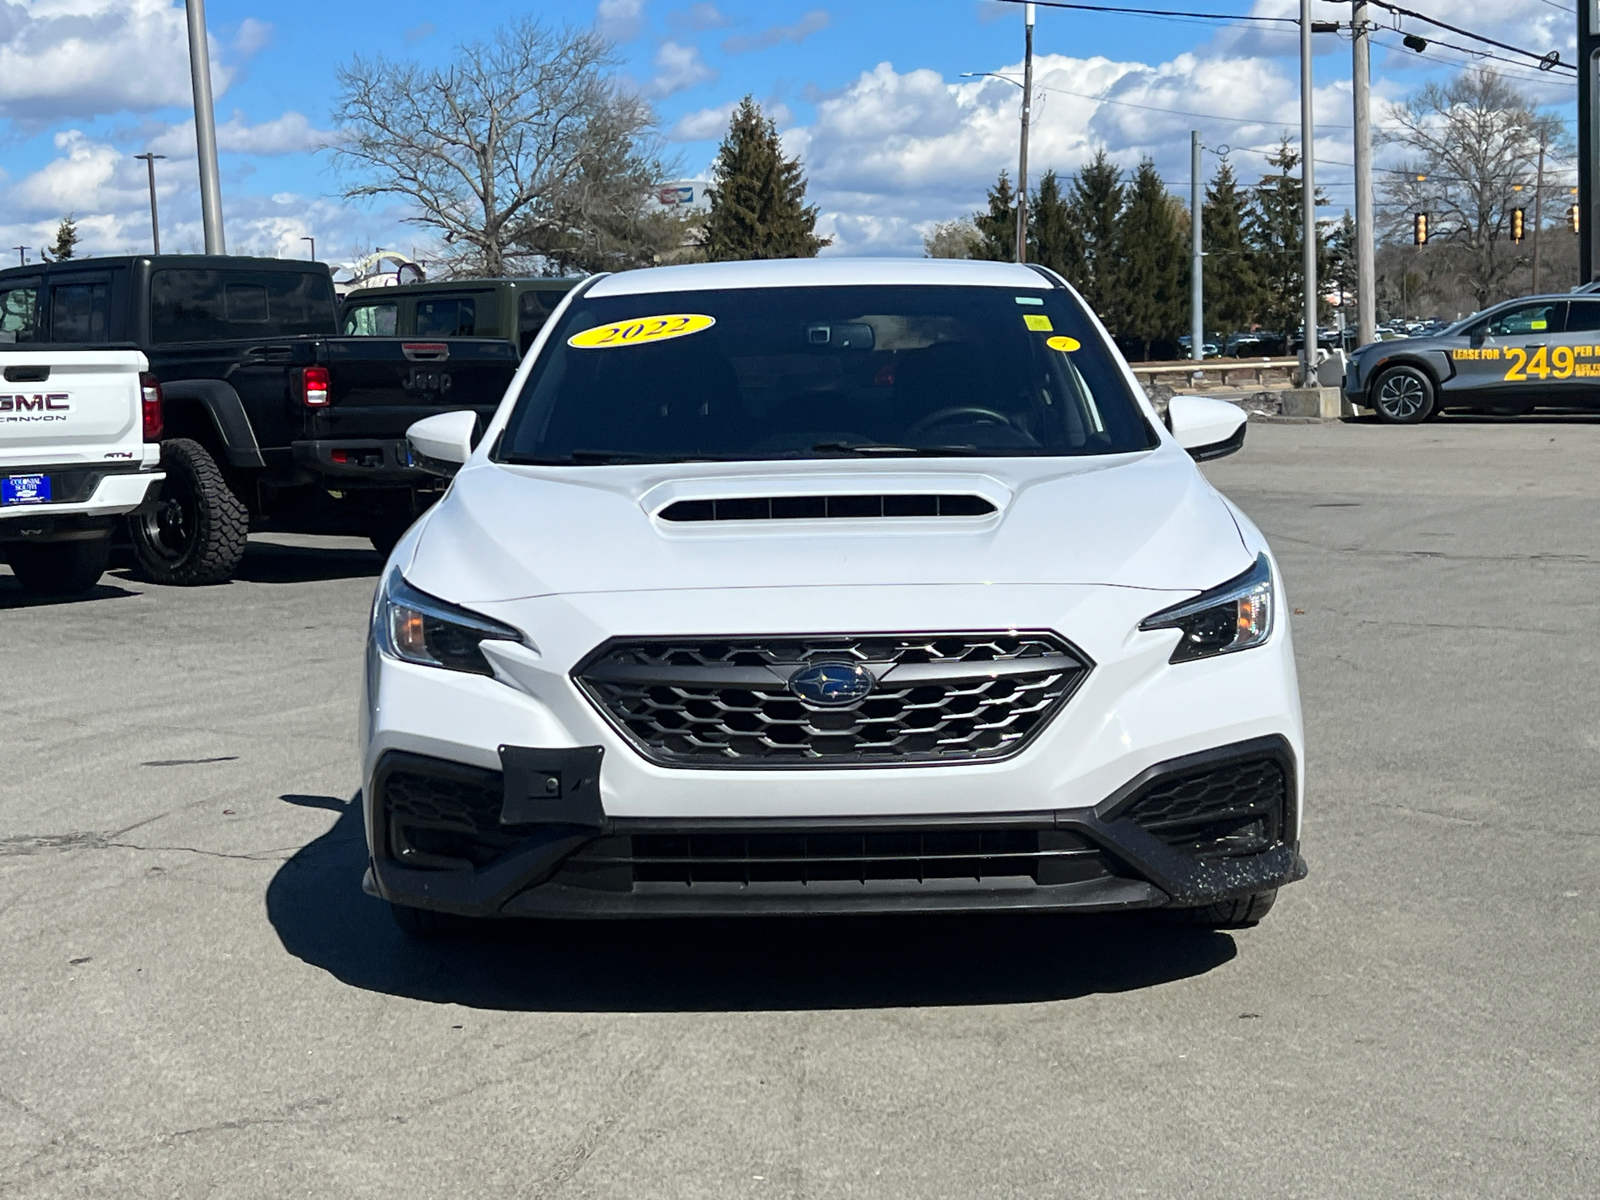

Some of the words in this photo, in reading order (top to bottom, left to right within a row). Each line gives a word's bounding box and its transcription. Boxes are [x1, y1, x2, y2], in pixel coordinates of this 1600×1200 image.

[596, 317, 691, 345] 2022
[1453, 348, 1480, 360] LEASE
[1481, 348, 1500, 360] FOR
[1574, 345, 1593, 357] PER
[402, 367, 452, 394] Jeep
[0, 393, 70, 412] GMC
